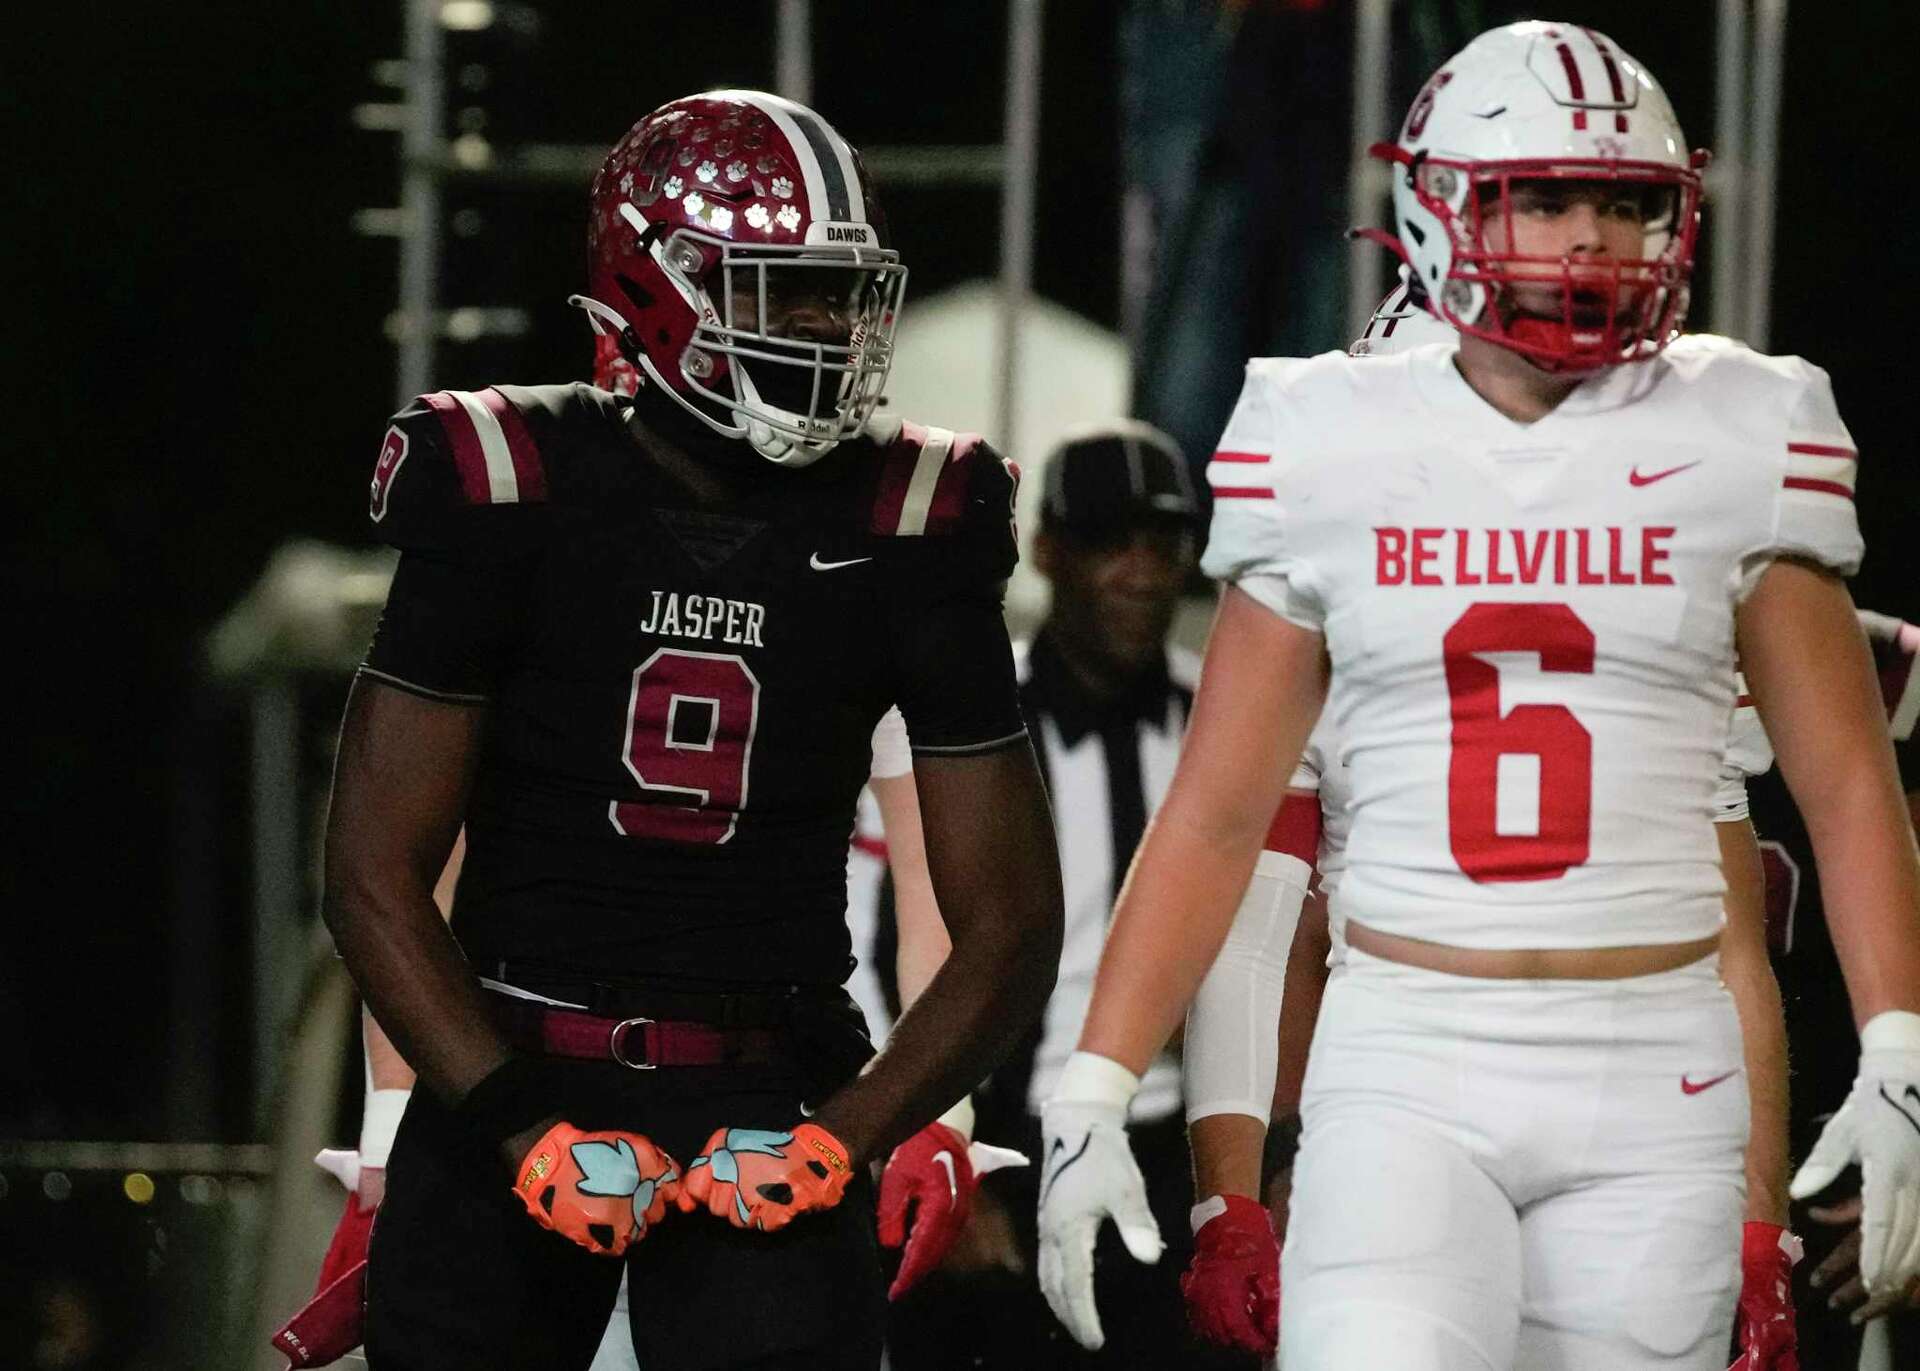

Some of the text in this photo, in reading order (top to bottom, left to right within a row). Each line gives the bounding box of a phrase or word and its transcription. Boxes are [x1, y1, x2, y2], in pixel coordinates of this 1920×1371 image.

[827, 227, 868, 243] DAWGS
[370, 424, 410, 523] 9
[1373, 527, 1676, 586] BELLVILLE
[640, 591, 764, 648] JASPER
[609, 647, 761, 846] 9
[1443, 602, 1596, 883] 6
